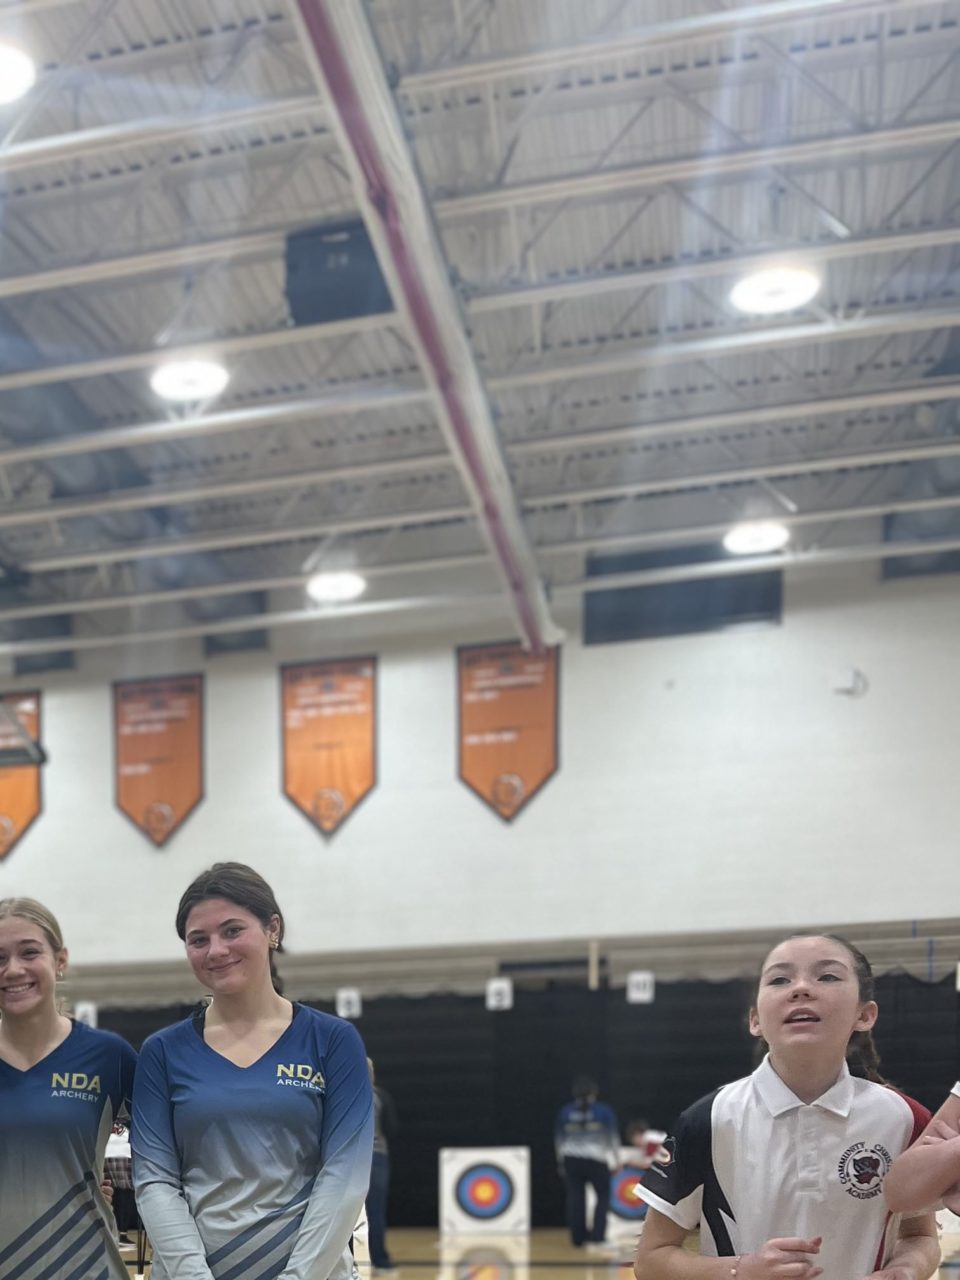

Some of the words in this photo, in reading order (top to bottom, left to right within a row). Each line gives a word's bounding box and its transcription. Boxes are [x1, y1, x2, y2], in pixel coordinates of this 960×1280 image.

[51, 1072, 101, 1094] NDA
[276, 1063, 325, 1089] NDA
[51, 1090, 99, 1103] ARCHERY
[838, 1141, 865, 1185] COMMUNITY
[845, 1187, 882, 1200] ACADEMY
